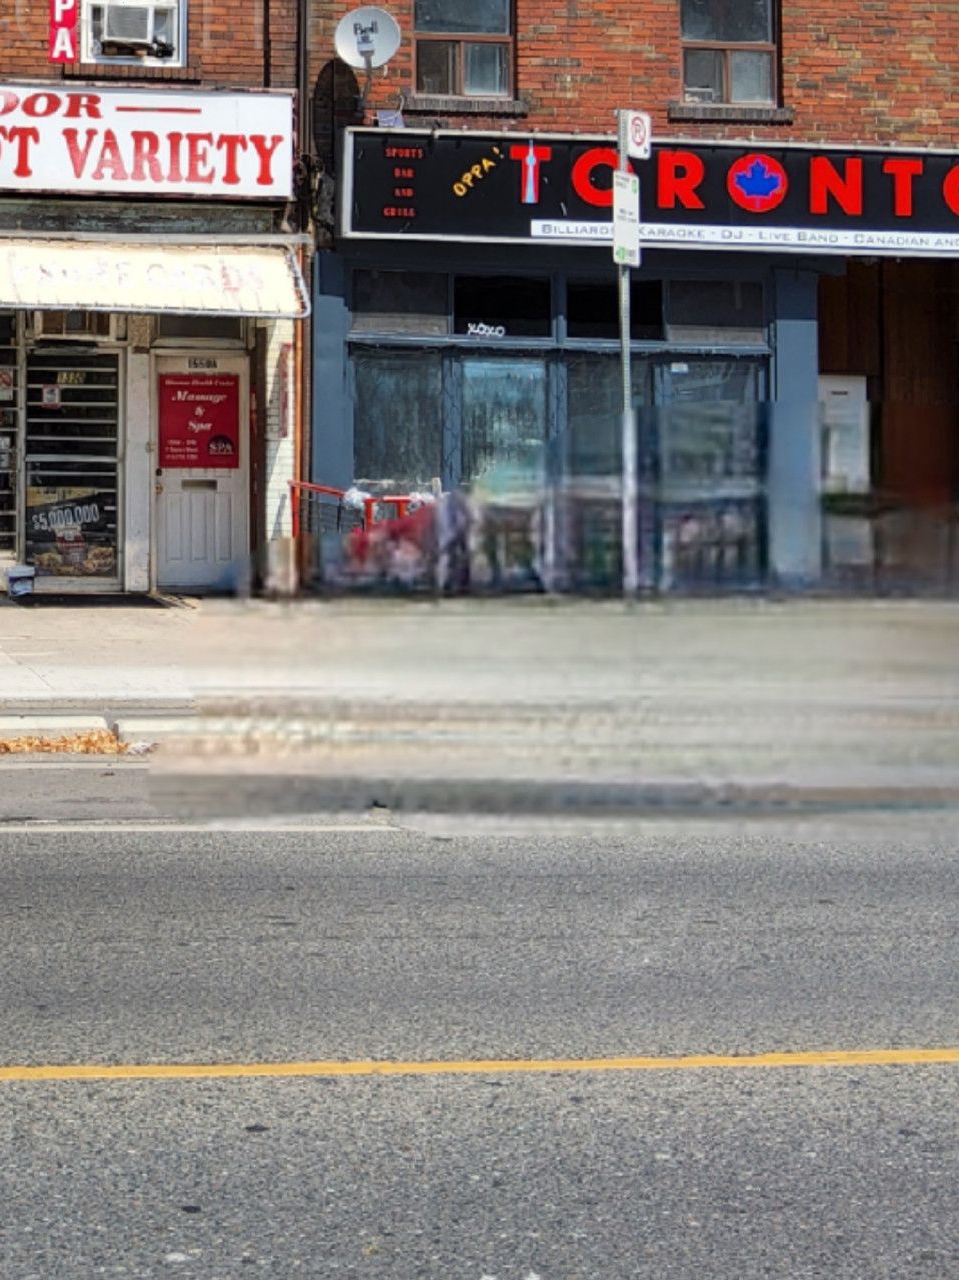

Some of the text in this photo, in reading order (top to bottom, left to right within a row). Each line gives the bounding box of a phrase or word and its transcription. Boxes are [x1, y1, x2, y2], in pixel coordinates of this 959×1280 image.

[62, 127, 284, 186] VARIETY
[385, 146, 424, 159] SPORTS
[394, 167, 414, 179] BAR
[509, 141, 959, 217] TORONT
[394, 187, 414, 197] AND
[383, 207, 417, 217] GRILL
[541, 223, 615, 236] BILLIARD
[171, 390, 228, 404] Massage
[187, 421, 213, 433] Spa
